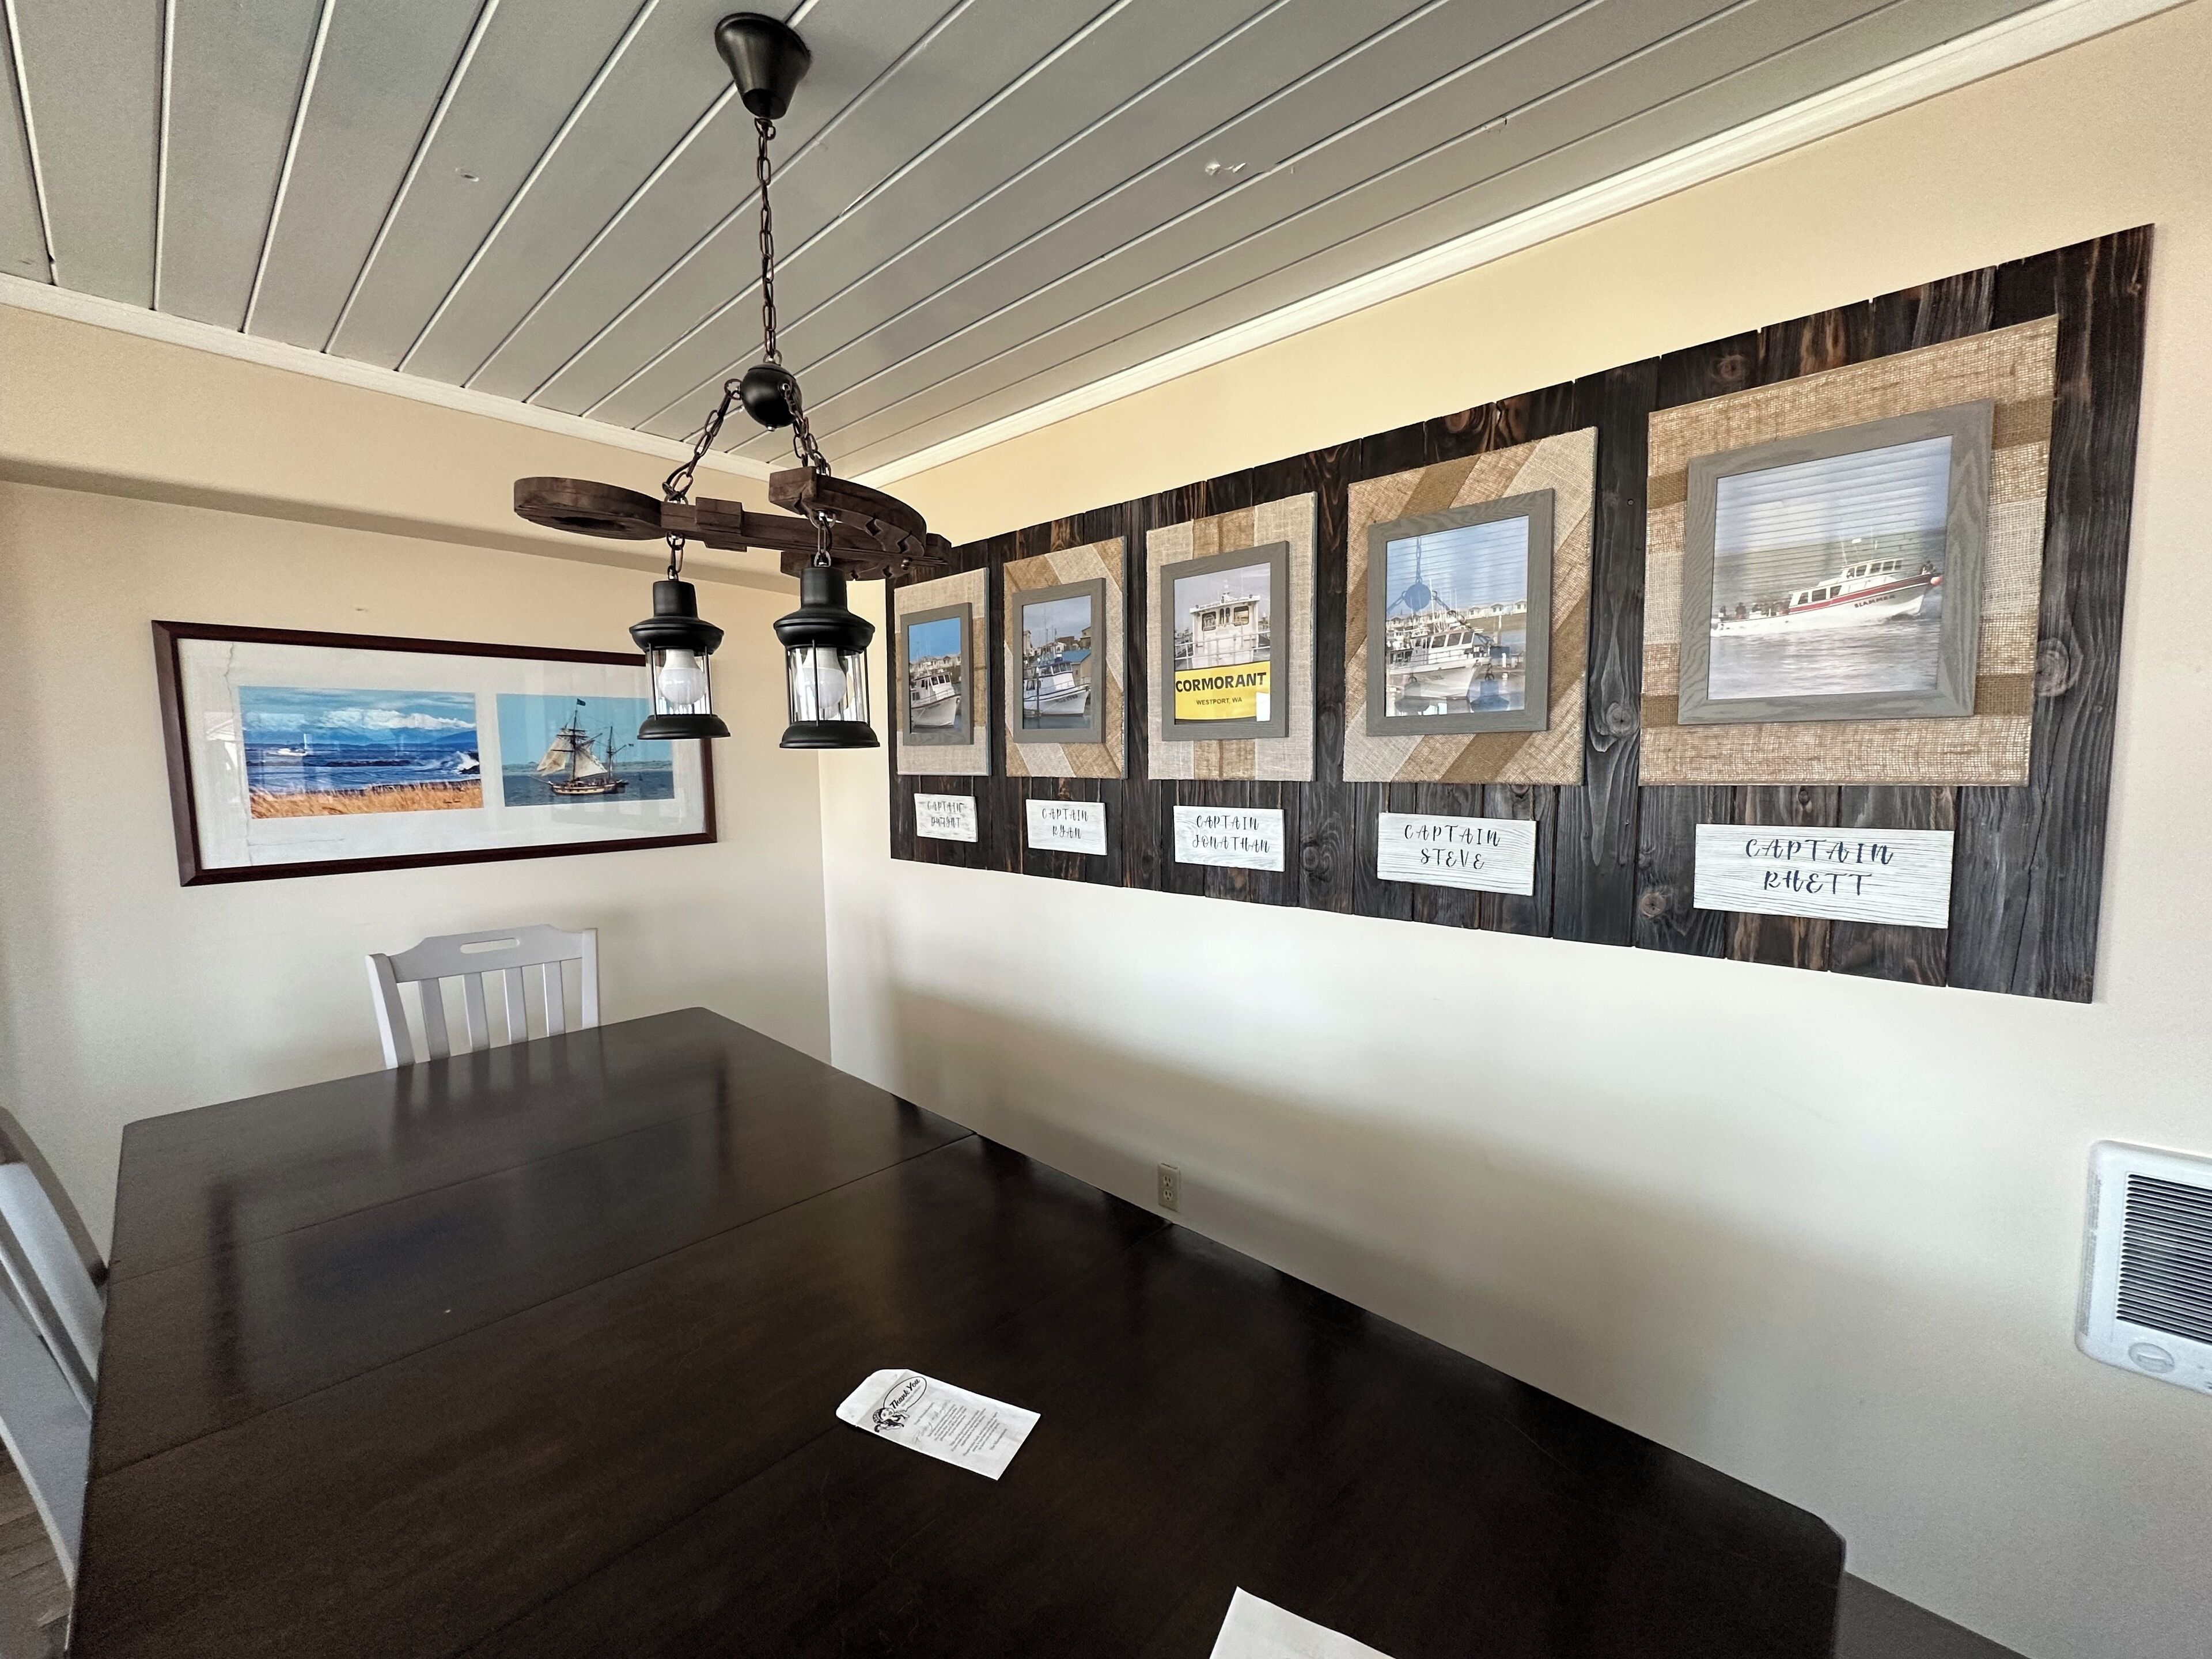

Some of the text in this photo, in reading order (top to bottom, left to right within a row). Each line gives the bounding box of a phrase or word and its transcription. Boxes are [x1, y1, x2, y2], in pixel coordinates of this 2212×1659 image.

[1854, 594, 1896, 608] SLAMMER
[1175, 672, 1267, 693] CORMORANT
[1041, 808, 1089, 822] CAPTAIN
[1196, 815, 1259, 831] CAPTAIN
[1052, 824, 1082, 839] RYAN
[1404, 824, 1501, 847] CAPTAIN
[1192, 834, 1270, 853] JONATHAN
[1745, 838, 1894, 865] CAPTAIN
[1420, 848, 1485, 870] STEVE
[1763, 870, 1872, 896] RHETT
[889, 1389, 910, 1409] Thank
[906, 1378, 921, 1391] You
